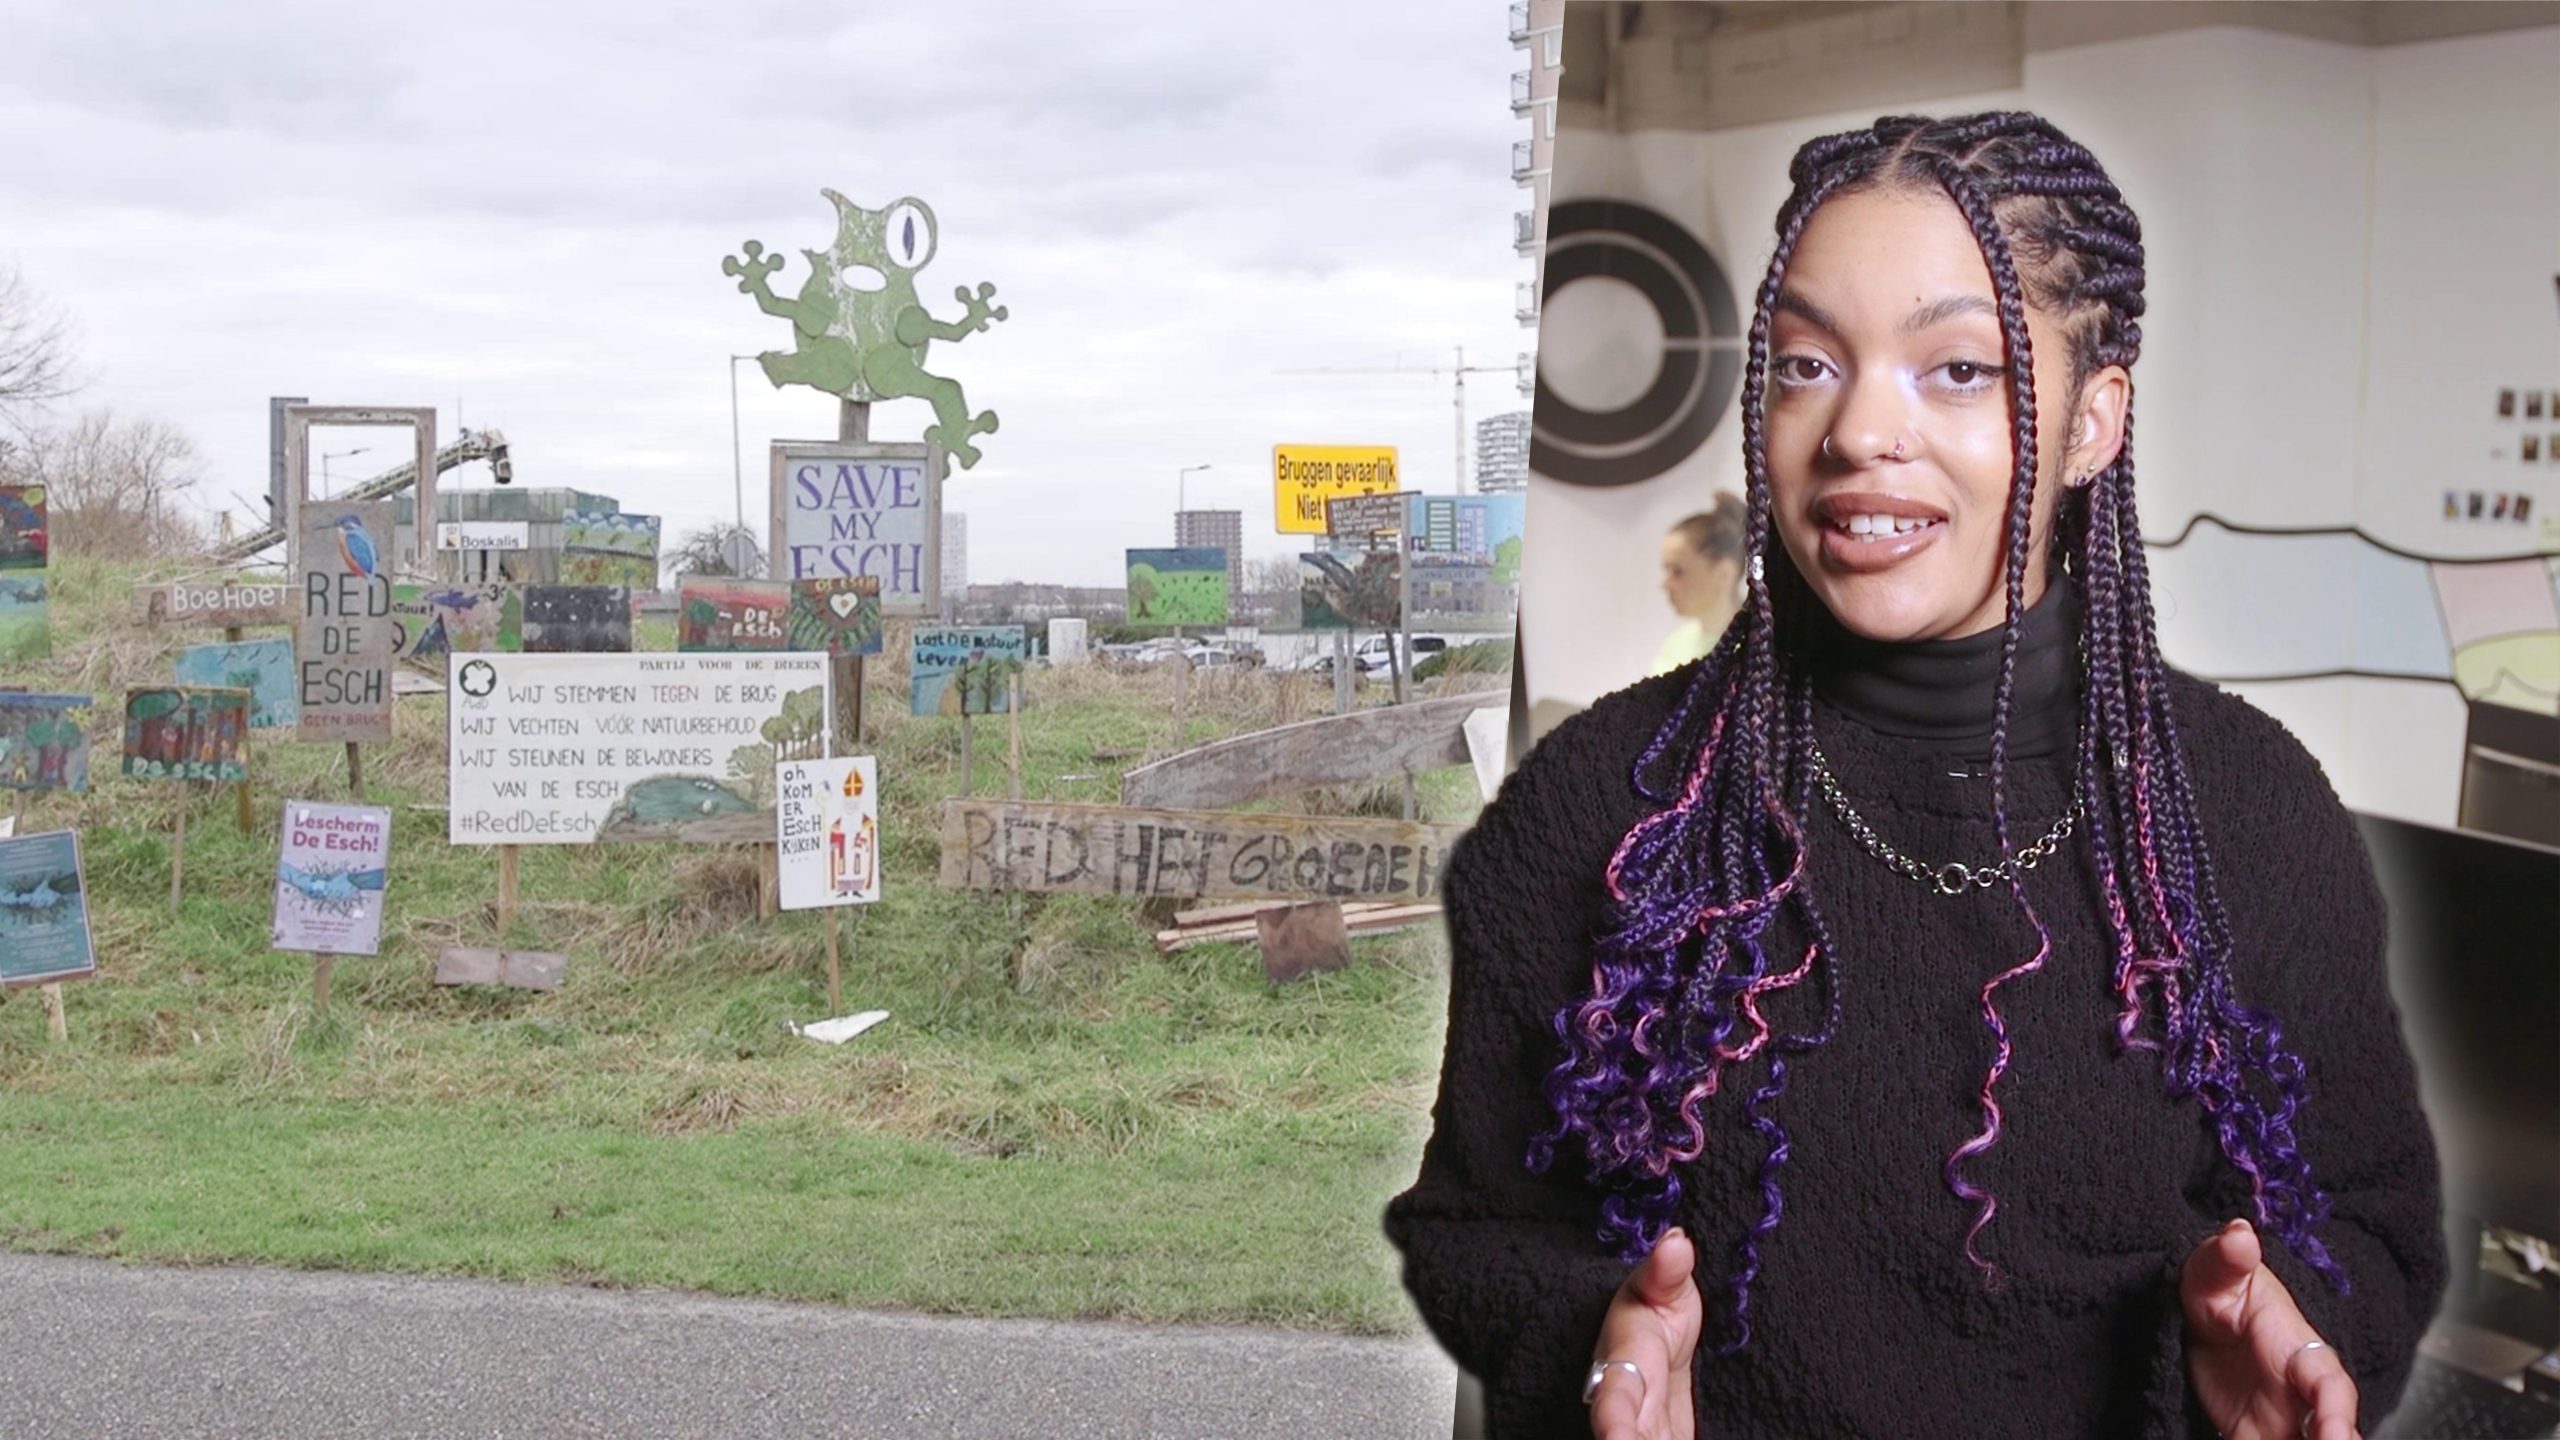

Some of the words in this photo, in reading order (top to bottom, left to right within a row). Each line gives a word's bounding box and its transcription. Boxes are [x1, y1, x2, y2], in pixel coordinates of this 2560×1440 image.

[1278, 454, 1332, 488] Bruggen
[1336, 456, 1397, 490] gevaarlijk
[796, 464, 921, 511] SAVE
[1297, 494, 1323, 520] Niet
[829, 511, 882, 541] MY
[461, 535, 520, 548] Boskalis
[790, 543, 922, 593] ESCH
[306, 571, 390, 618] RED
[323, 626, 361, 655] DE
[639, 660, 685, 671] PARTIJ
[698, 660, 732, 671] VOOR
[745, 660, 763, 670] DE
[774, 659, 821, 670] DIEREN
[302, 661, 382, 706] ESCH
[508, 685, 544, 704] WIJ
[554, 685, 636, 704] STEMMEN
[652, 684, 699, 703] TEGEN
[715, 684, 733, 703] DE
[741, 684, 777, 703] BRUG
[460, 717, 496, 736] WIJ
[508, 717, 579, 735] VECHTEN
[643, 716, 756, 735] NATUURBEHOUD
[460, 748, 496, 768] WIJ
[508, 748, 584, 767] STEUNEN
[597, 748, 616, 767] DE
[625, 748, 713, 767] BEWONERS
[493, 780, 526, 798] VAN
[541, 780, 560, 799] DE
[575, 780, 619, 799] ESCH
[784, 802, 804, 816] ER
[460, 810, 597, 833] #RedDeEsch
[292, 831, 320, 848] De
[325, 833, 379, 853] Esch!
[964, 810, 1093, 890] RED
[1113, 818, 1228, 898] HET
